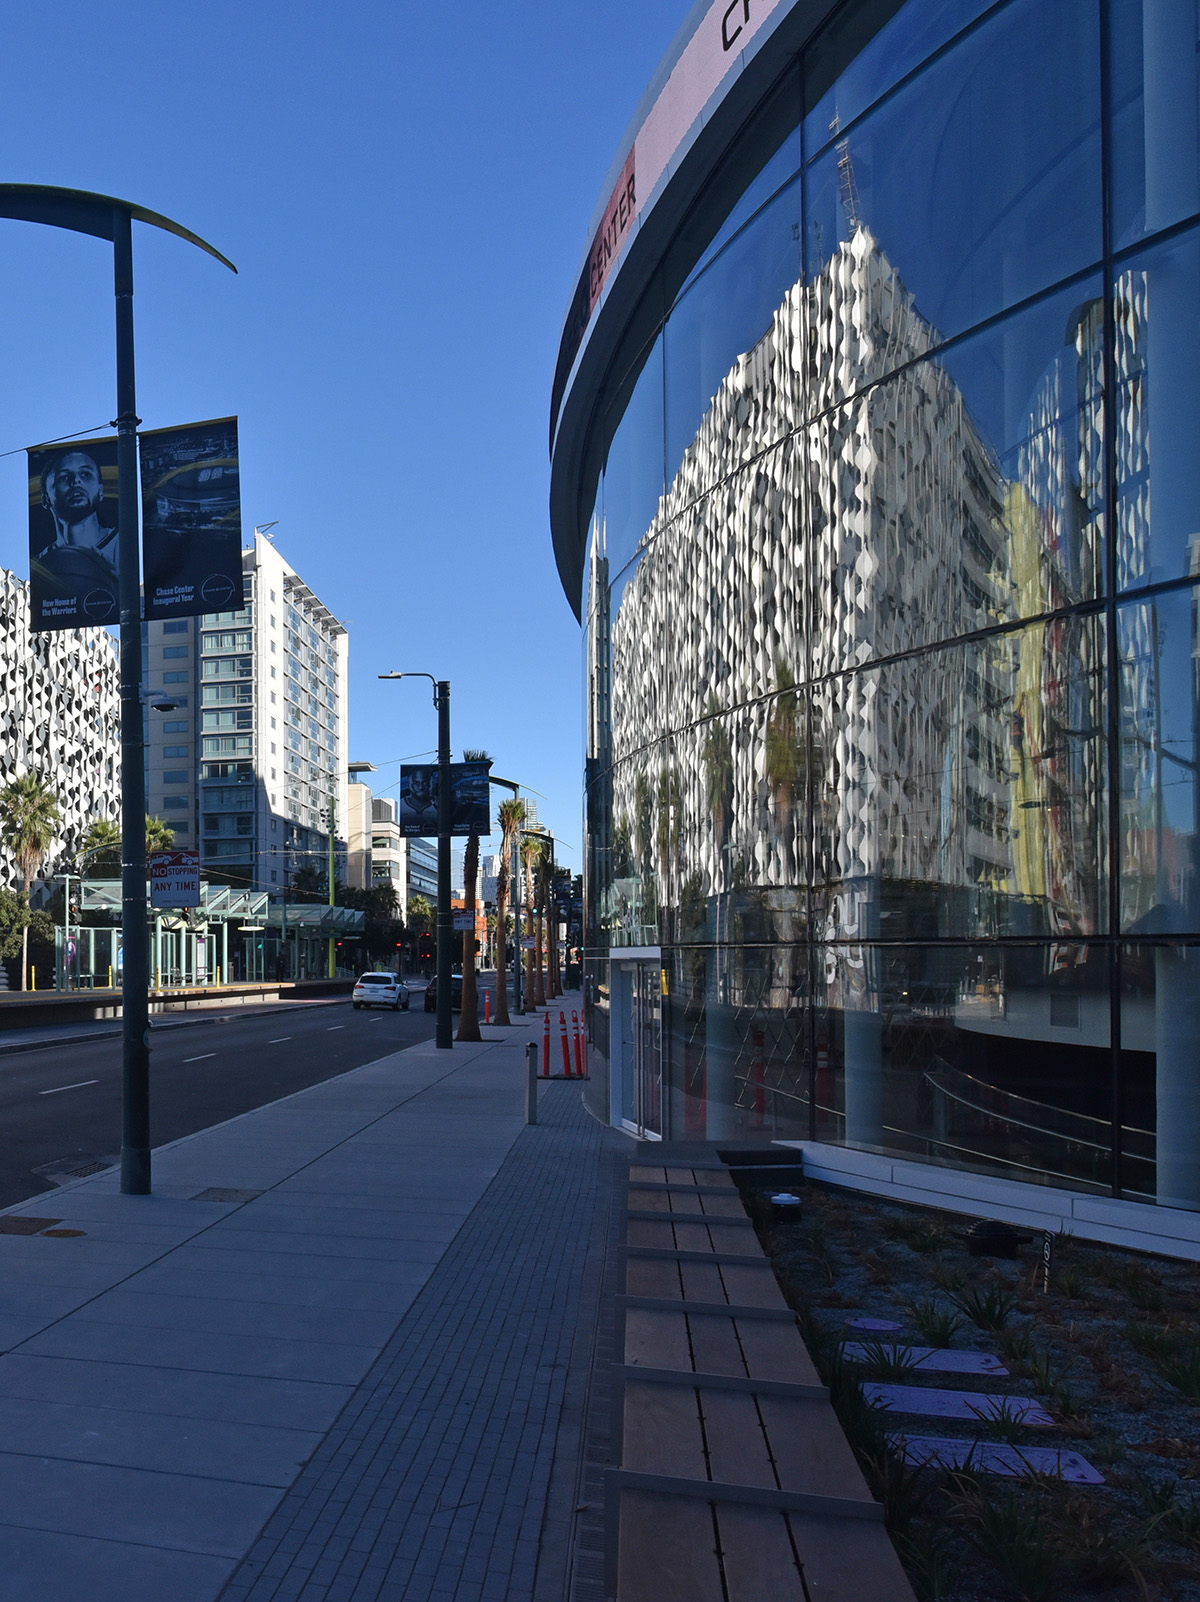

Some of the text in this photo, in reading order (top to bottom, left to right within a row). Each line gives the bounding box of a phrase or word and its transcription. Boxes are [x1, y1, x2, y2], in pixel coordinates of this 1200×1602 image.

[590, 173, 636, 298] CENTER
[156, 586, 174, 596] Chase
[174, 585, 194, 595] Center
[42, 600, 54, 608] New
[55, 598, 70, 607] Home
[153, 594, 194, 605] Inaugural Year
[42, 606, 77, 616] the Warriors
[153, 866, 198, 876] NO STOPPING
[154, 881, 197, 891] ANY TIME
